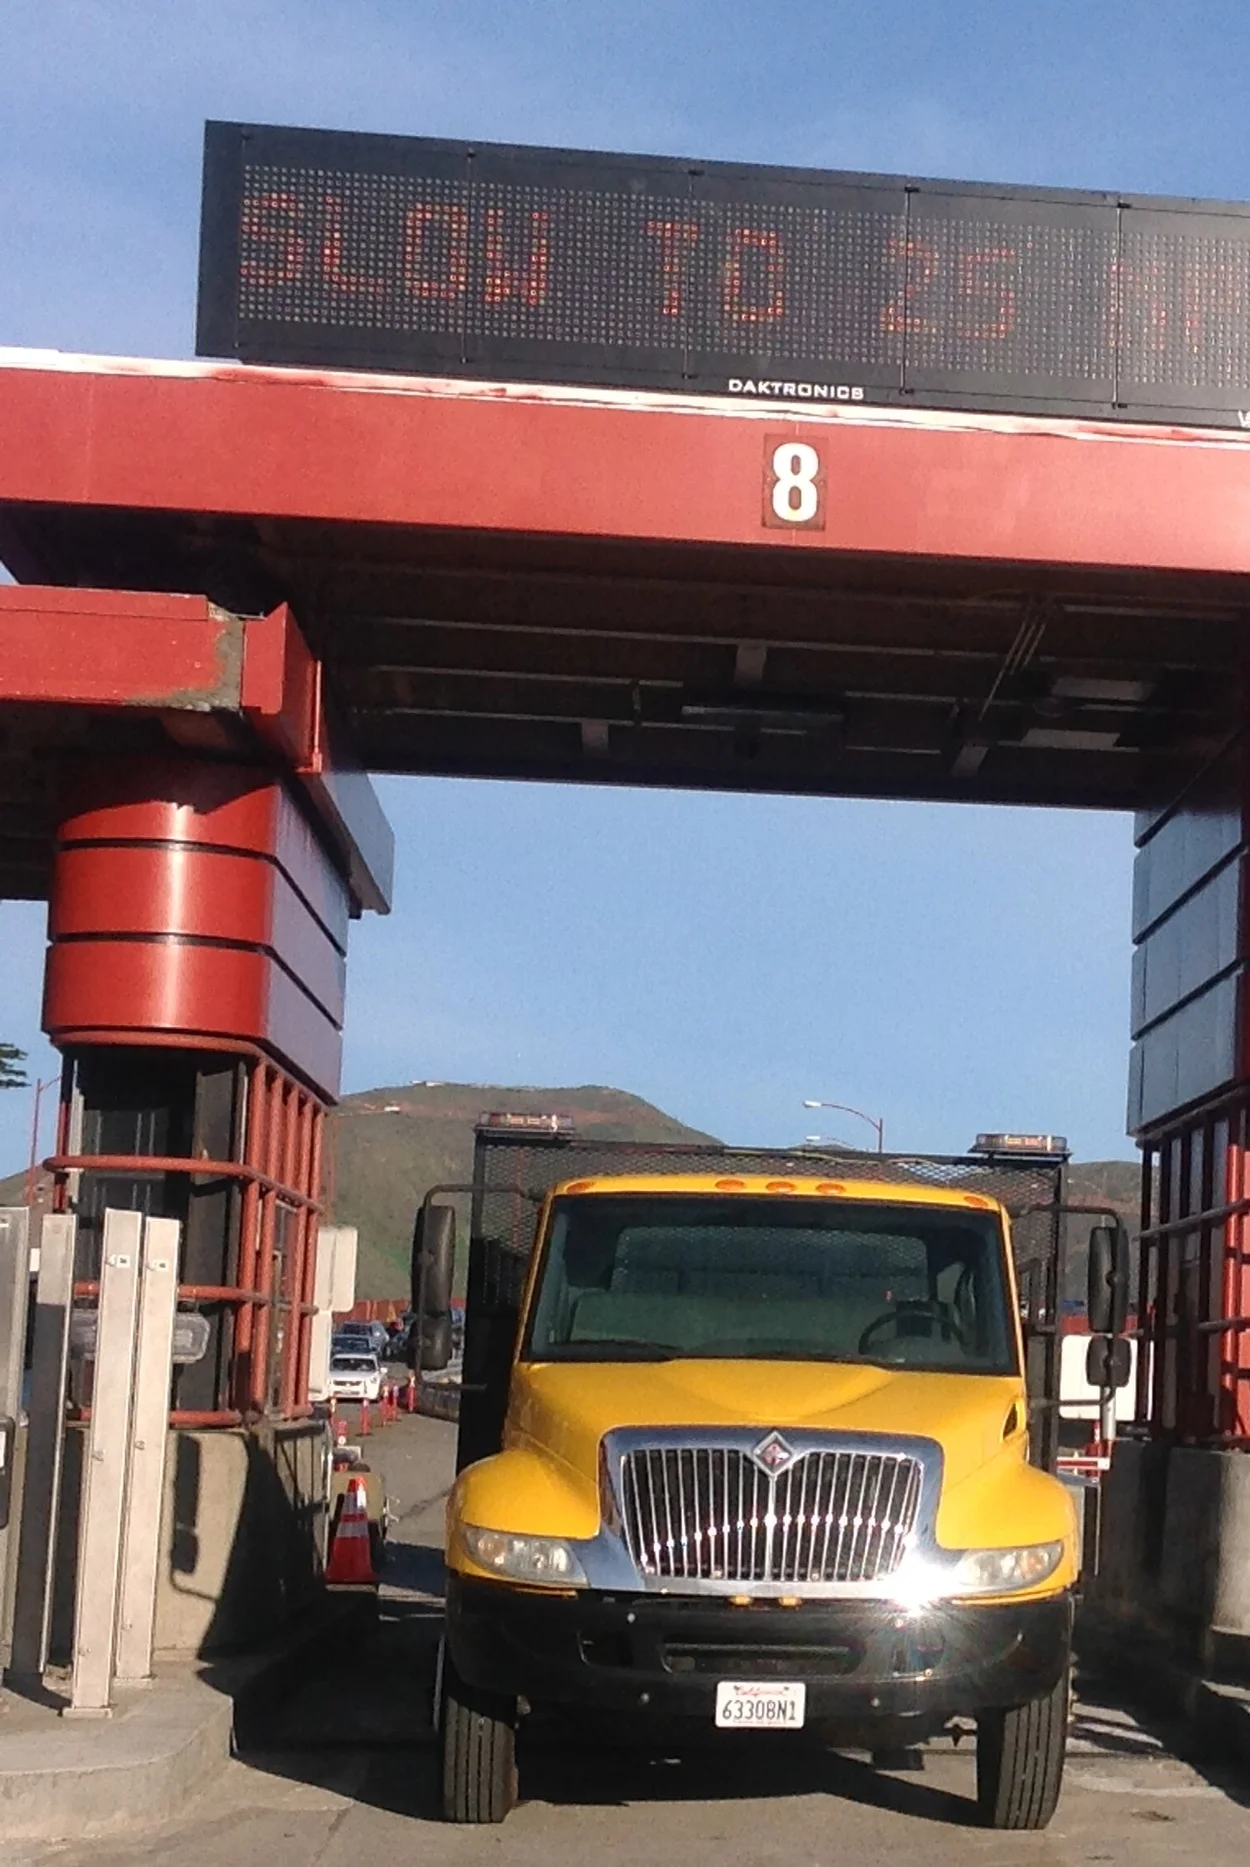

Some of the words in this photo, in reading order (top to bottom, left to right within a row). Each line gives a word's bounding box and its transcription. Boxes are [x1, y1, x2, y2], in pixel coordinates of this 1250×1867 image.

[239, 192, 549, 306] SLOW
[644, 219, 788, 321] TO
[881, 238, 1017, 340] 25
[728, 378, 865, 400] DAKTRONICS
[772, 441, 819, 522] 8
